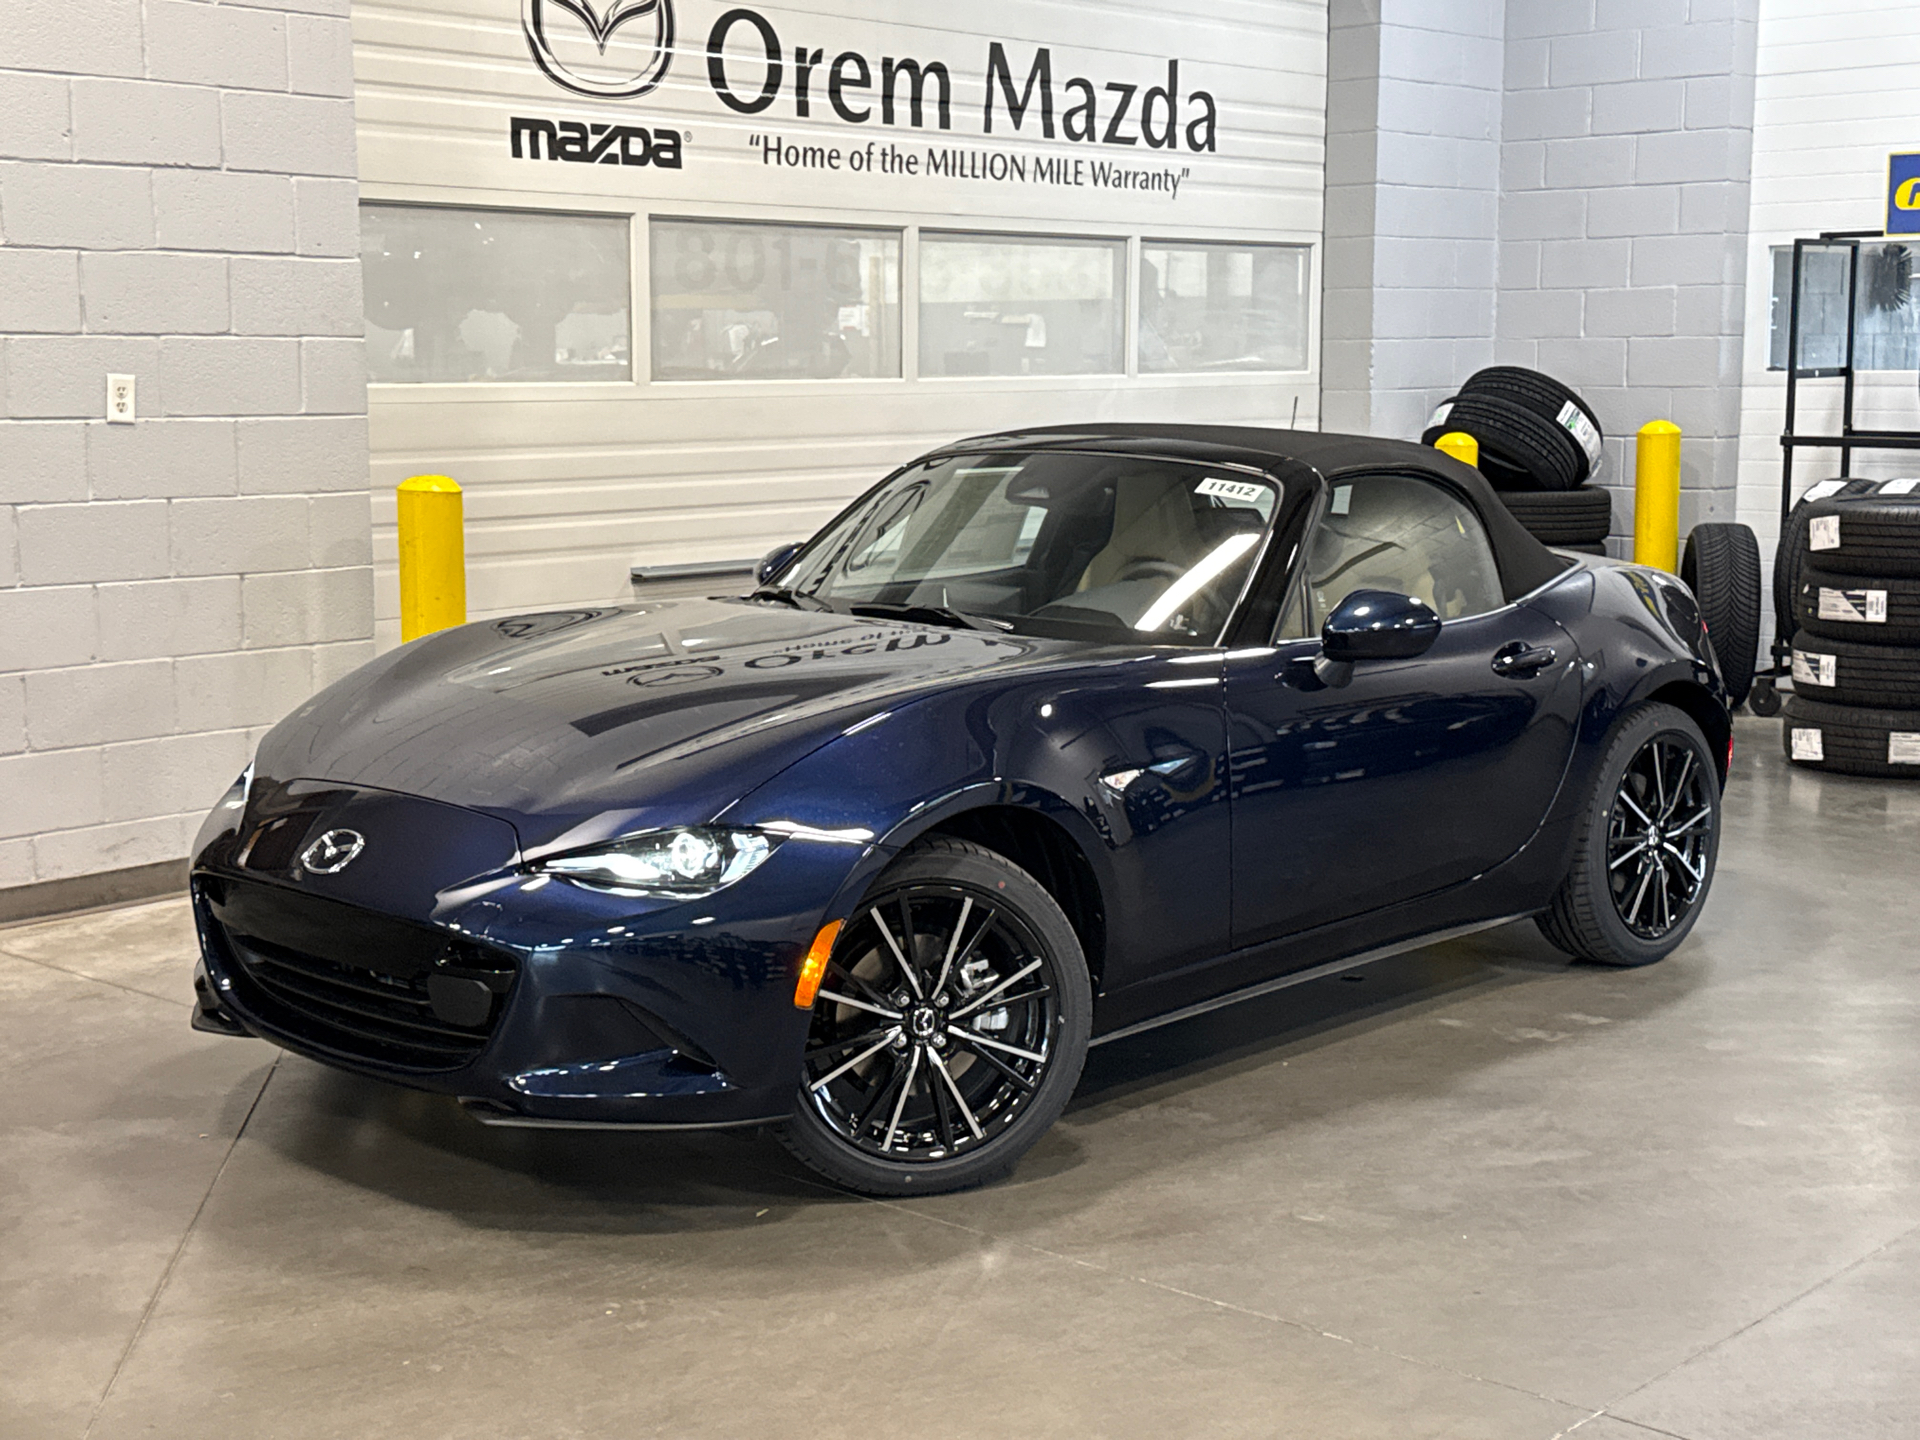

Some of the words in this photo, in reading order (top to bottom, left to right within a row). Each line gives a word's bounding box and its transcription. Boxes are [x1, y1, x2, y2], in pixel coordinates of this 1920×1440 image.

[706, 8, 952, 130] Orem
[983, 41, 1217, 153] Mazda
[510, 116, 683, 169] mazda
[849, 142, 876, 172] of
[880, 143, 919, 176] the
[926, 148, 1027, 183] MILLION
[1033, 156, 1084, 186] MILE
[1209, 481, 1256, 496] 11412
